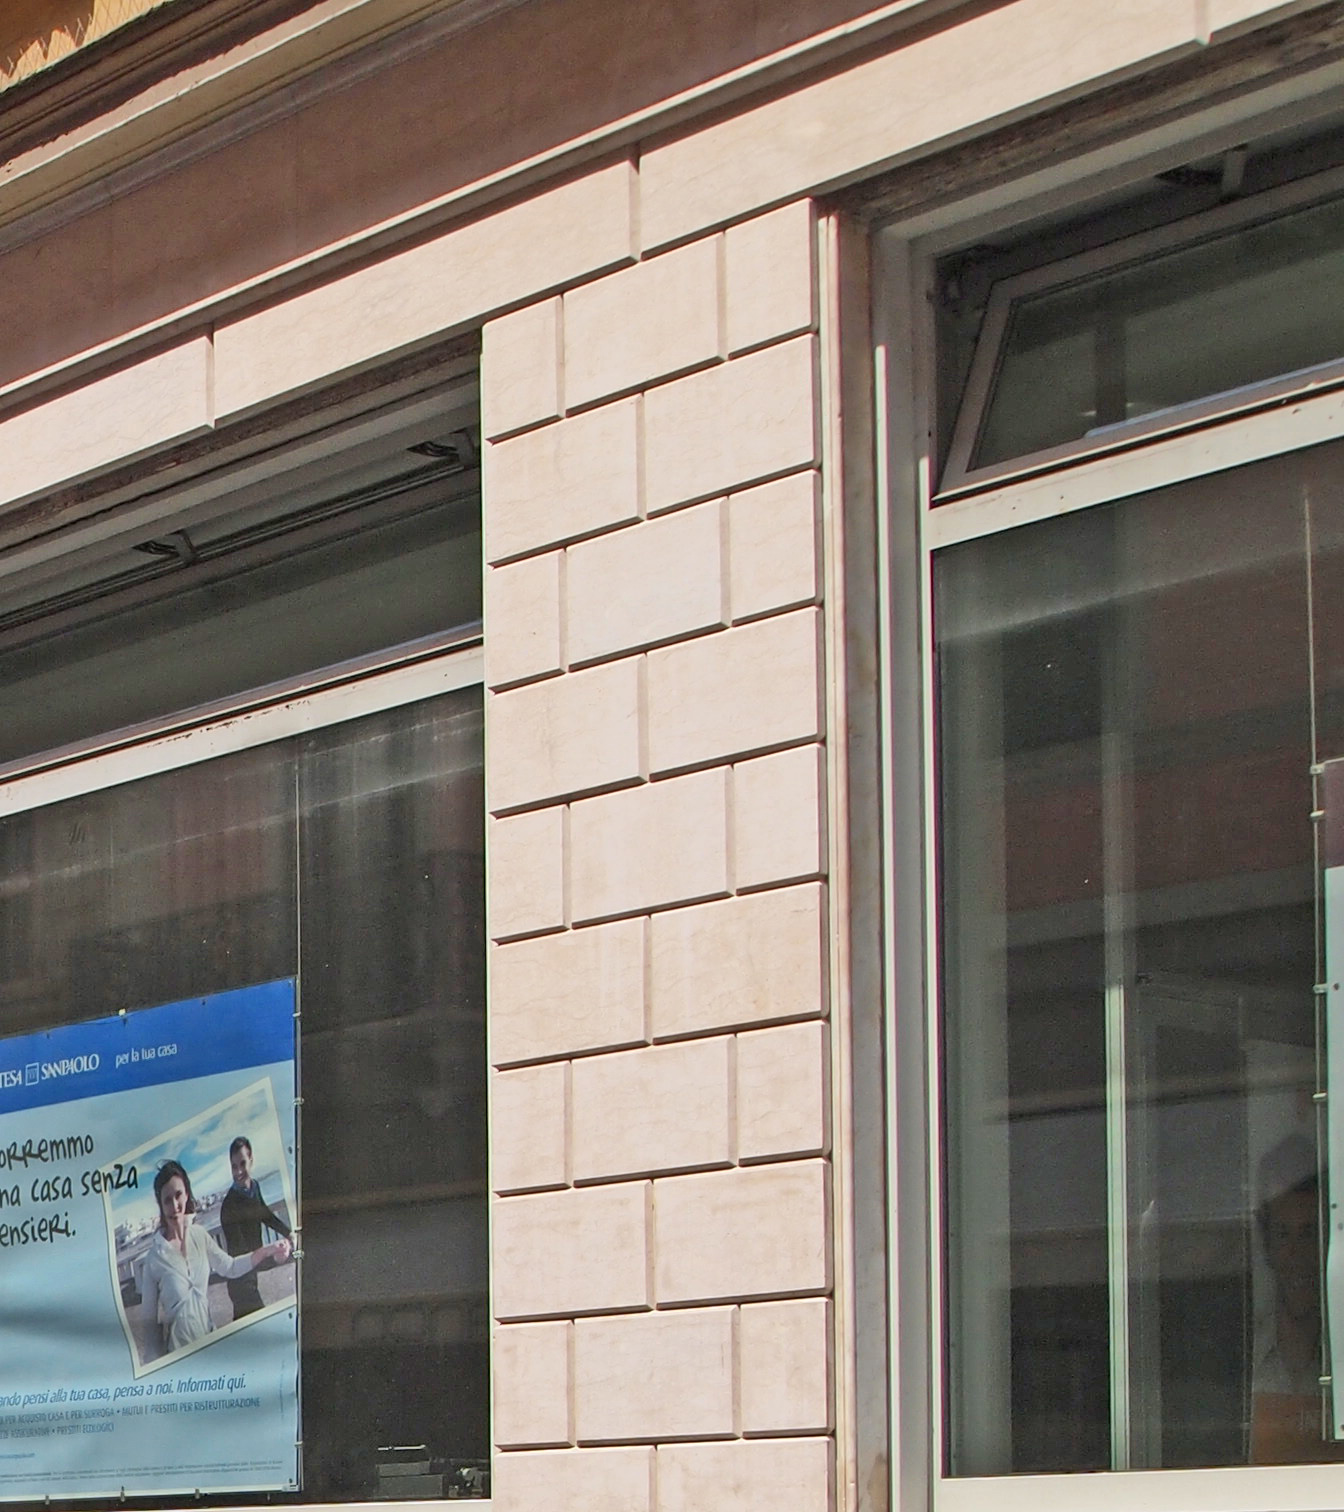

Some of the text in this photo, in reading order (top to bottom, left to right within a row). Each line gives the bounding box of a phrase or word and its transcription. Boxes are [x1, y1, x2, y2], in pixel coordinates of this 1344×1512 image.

[41, 1053, 100, 1080] SANPAOLO
[115, 1053, 130, 1068] per
[131, 1047, 140, 1063] la
[141, 1046, 155, 1060] tua
[157, 1043, 178, 1057] casa
[30, 1175, 73, 1203] casa
[81, 1163, 139, 1197] senza
[22, 1389, 50, 1408] pensi
[50, 1387, 68, 1403] alla
[70, 1388, 86, 1401] tua
[87, 1388, 110, 1402] casa,
[113, 1385, 144, 1400] pensa
[146, 1385, 153, 1396] a
[155, 1379, 174, 1396] noi.
[177, 1375, 226, 1393] Informati
[227, 1373, 246, 1393] qui.
[47, 1411, 65, 1422] CASA
[71, 1409, 83, 1420] PER
[151, 1403, 178, 1414] PRESTITI
[179, 1402, 193, 1412] PER
